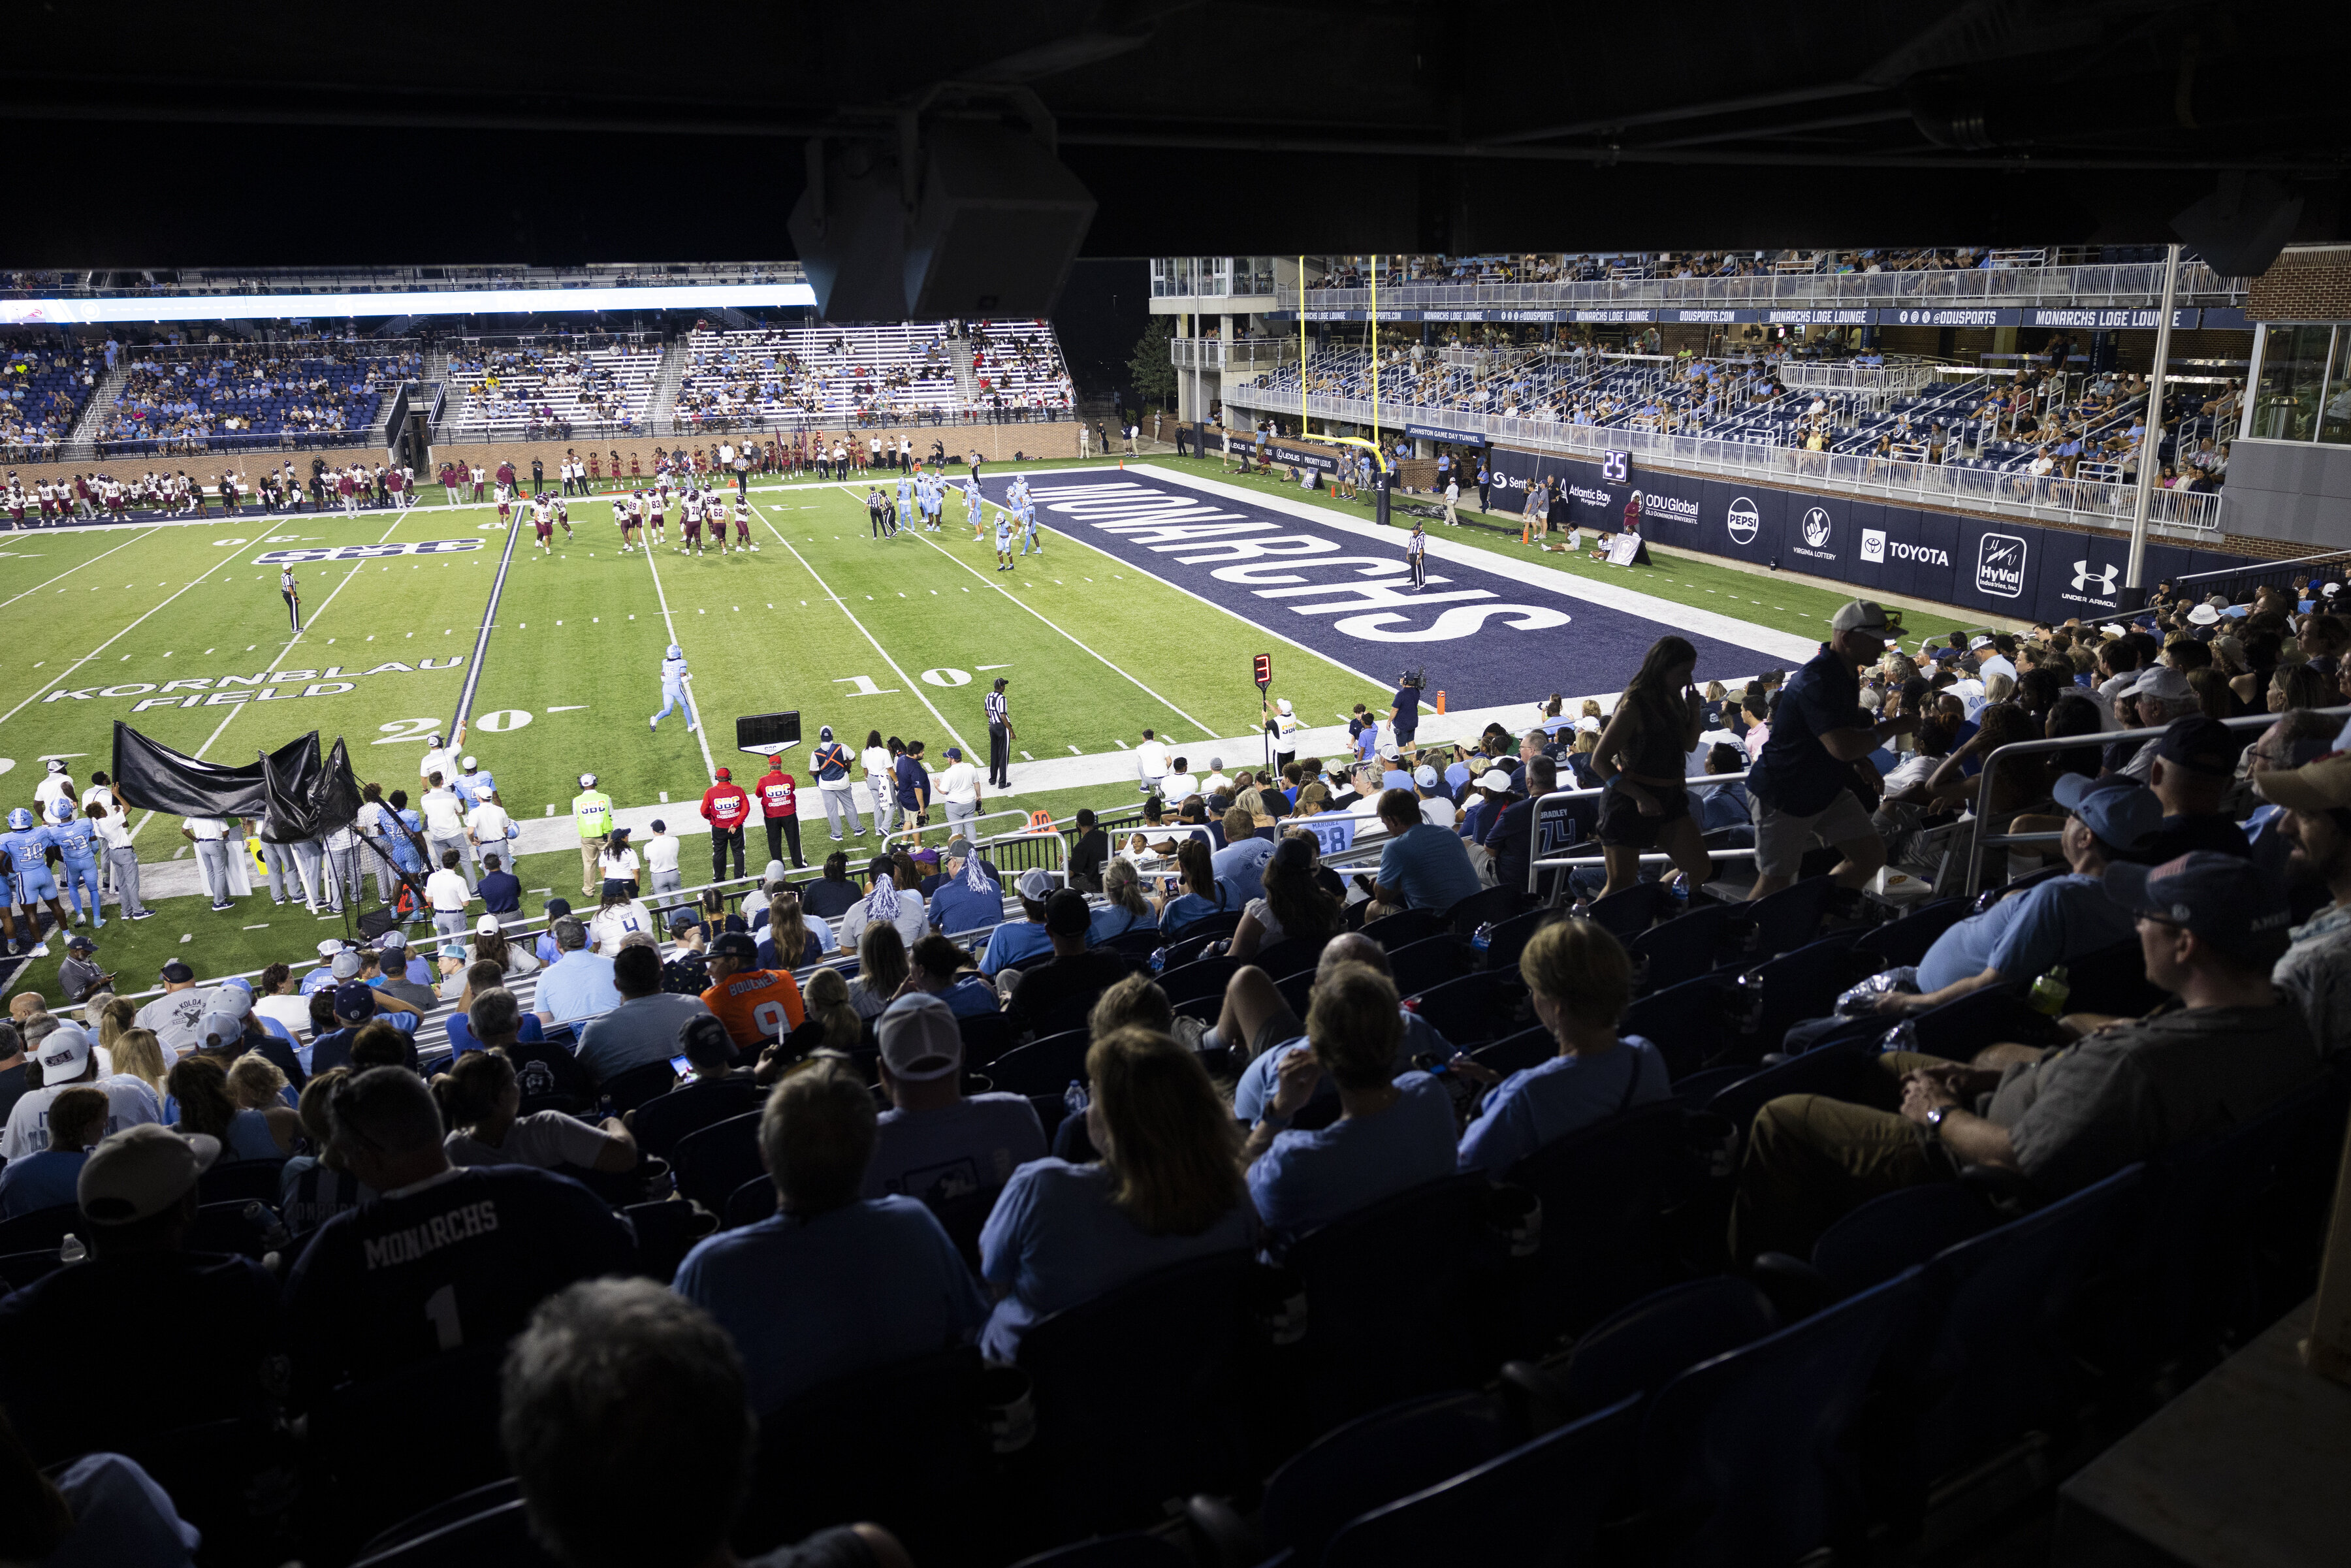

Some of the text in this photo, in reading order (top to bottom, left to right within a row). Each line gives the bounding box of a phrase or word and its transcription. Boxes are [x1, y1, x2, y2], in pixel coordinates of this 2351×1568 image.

[1424, 312, 1448, 320] MONARCHS
[1463, 312, 1482, 321] LOUNGE
[1520, 312, 1554, 321] @ODUSPORTS
[1576, 311, 1649, 321] MONARCHS LOGE LOUNGE
[1680, 311, 1735, 322] ODUSPORTS.COM
[1770, 311, 1866, 323] MONARCHS LOGE LOUNGE
[1933, 311, 1996, 325] @ODUSPORTS
[2036, 311, 2181, 327] MONARCHS LOGE LOUNE
[1409, 428, 1434, 436] JOHNSTON
[1459, 434, 1480, 443] TUNNEL
[1230, 442, 1245, 451] LEXUS
[1282, 452, 1300, 461] LEXUS
[1305, 456, 1331, 468] PRIORITY LEXUS
[1604, 452, 1625, 479] 25
[1569, 484, 1595, 500] Atlantic
[652, 500, 661, 509] 83
[1580, 498, 1595, 506] Mortgage
[714, 508, 723, 517] 62
[1730, 514, 1757, 528] PEPSI
[251, 538, 487, 565] SBC
[1793, 547, 1836, 560] VIRGINIA LOTTERY
[1890, 541, 1949, 566] TOYOTA
[1031, 482, 1572, 643] MONARCHS
[1981, 565, 2019, 584] HyVal
[1979, 579, 2007, 590] Industries,
[2062, 593, 2117, 608] UNDER ARMOU
[1256, 656, 1270, 682] 3
[41, 656, 466, 703] KORNBLAU
[131, 682, 357, 712] FIELD
[765, 784, 790, 798] SBC
[580, 800, 605, 814] SBC
[714, 796, 740, 810] SBC
[1541, 808, 1567, 819] BRADLEY
[1035, 814, 1049, 832] 10
[1540, 818, 1575, 852] 74
[19, 842, 43, 863] 30
[622, 918, 640, 933] 4
[728, 973, 779, 997] BOUCHER
[179, 999, 201, 1010] KOLOA
[753, 1000, 793, 1036] 9
[362, 1200, 499, 1272] MONARCHS
[424, 1283, 465, 1352] 1
